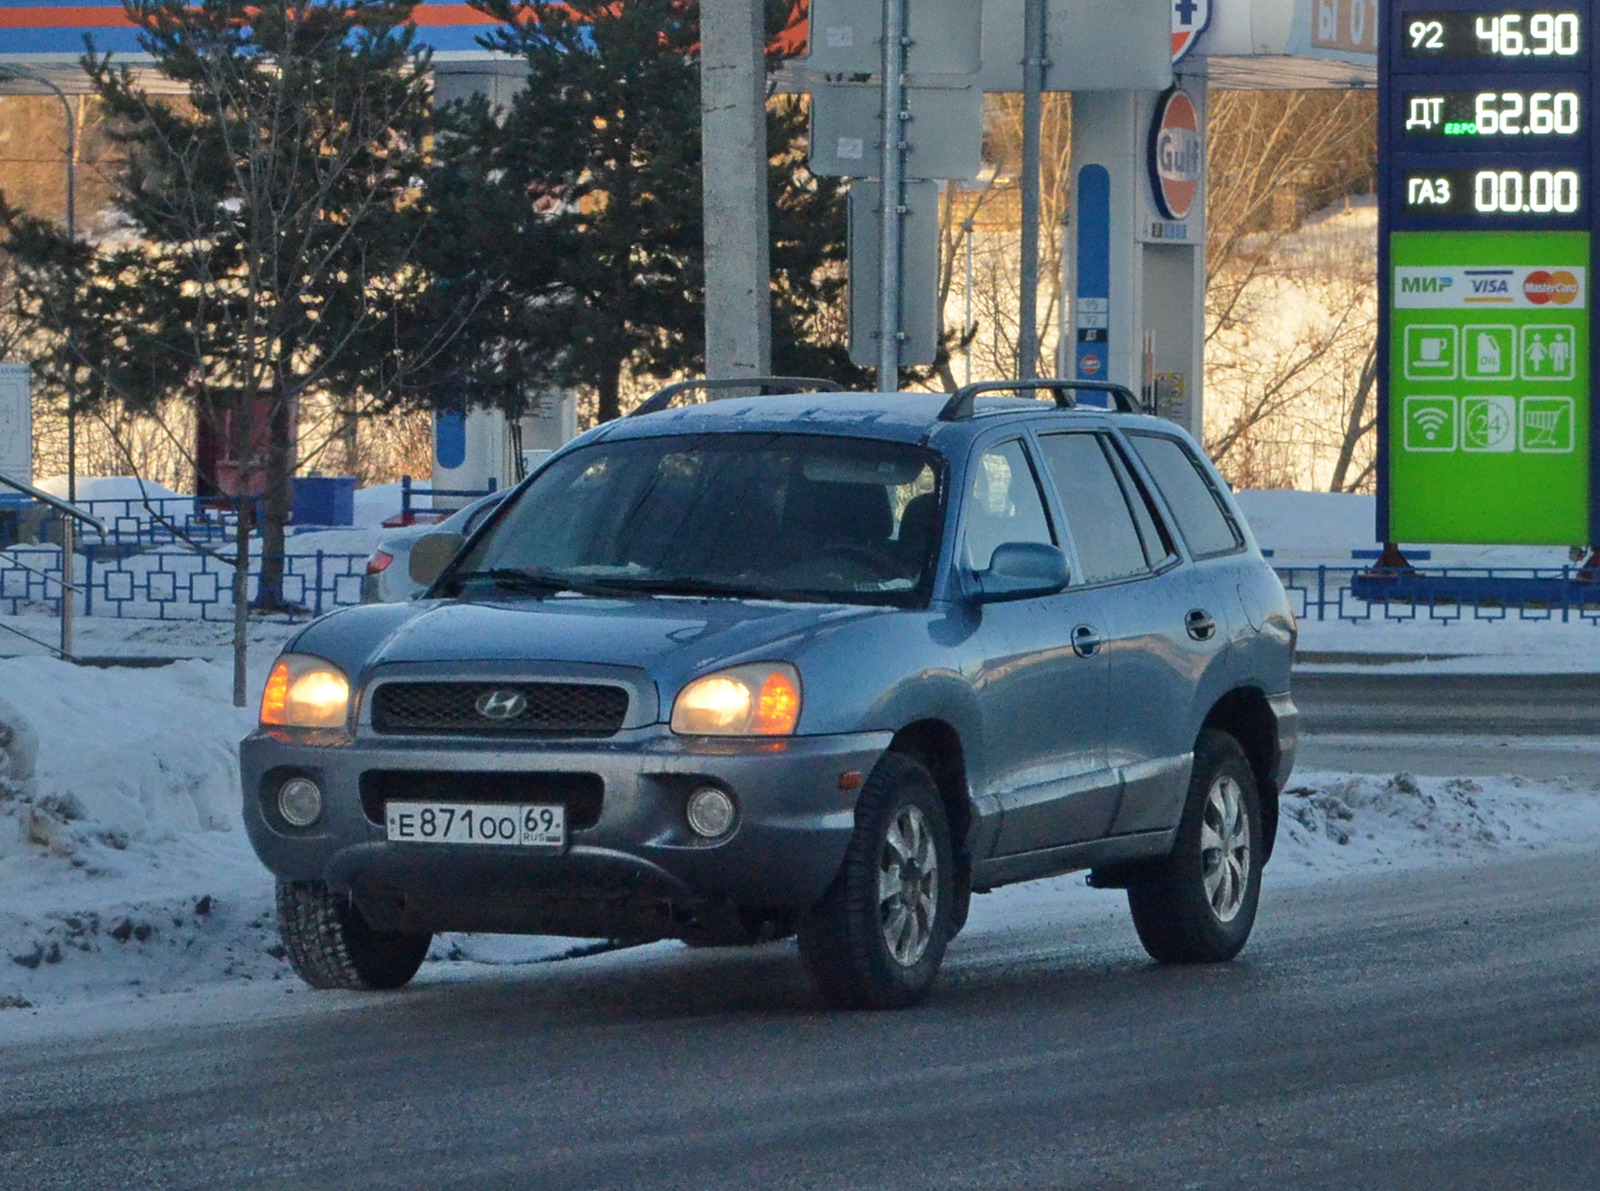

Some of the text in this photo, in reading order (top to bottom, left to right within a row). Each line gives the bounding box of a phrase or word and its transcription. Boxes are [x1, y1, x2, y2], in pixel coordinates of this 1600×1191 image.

[1409, 14, 1578, 55] 92 46.90
[1406, 98, 1444, 130] ДТ
[1475, 93, 1578, 134] 62.60
[1408, 171, 1578, 212] ГАЗ 00.00
[1401, 276, 1453, 293] МИР
[1471, 279, 1509, 293] VISA
[1524, 283, 1577, 293] MasterCard
[1480, 356, 1498, 366] OIL
[1476, 414, 1501, 435] 24
[524, 808, 554, 832] 69
[523, 832, 546, 842] RUS
